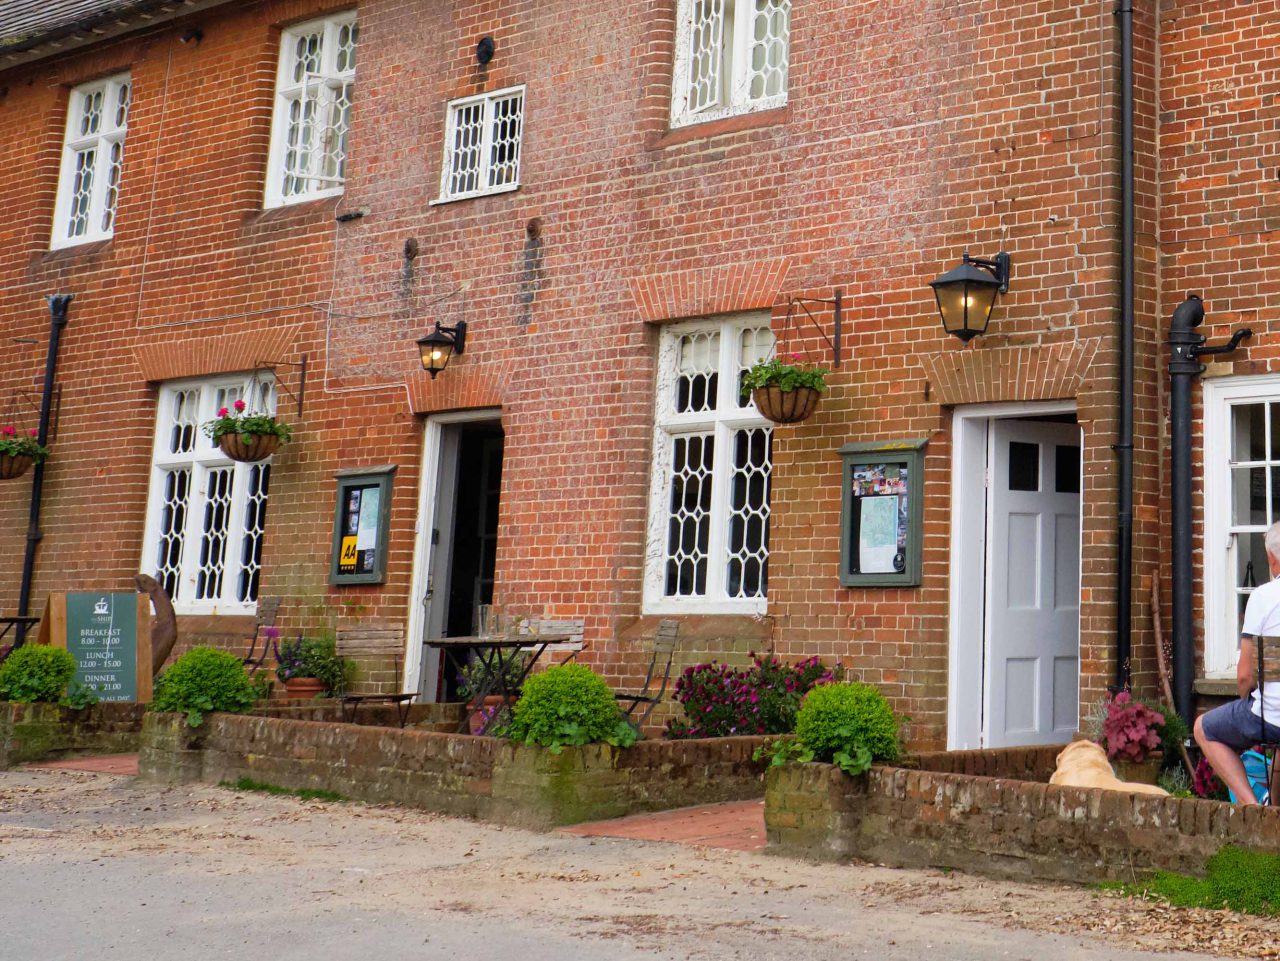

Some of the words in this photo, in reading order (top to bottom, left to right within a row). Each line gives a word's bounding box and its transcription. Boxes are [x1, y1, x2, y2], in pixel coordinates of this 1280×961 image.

[343, 544, 357, 560] AA
[80, 628, 121, 636] BREAKFAST
[81, 637, 95, 645] 8.00
[102, 637, 120, 645] 10.00
[86, 651, 114, 659] LUNCH
[104, 660, 121, 668] 15.00
[85, 674, 116, 682] DINNER
[104, 683, 121, 691] 21.00
